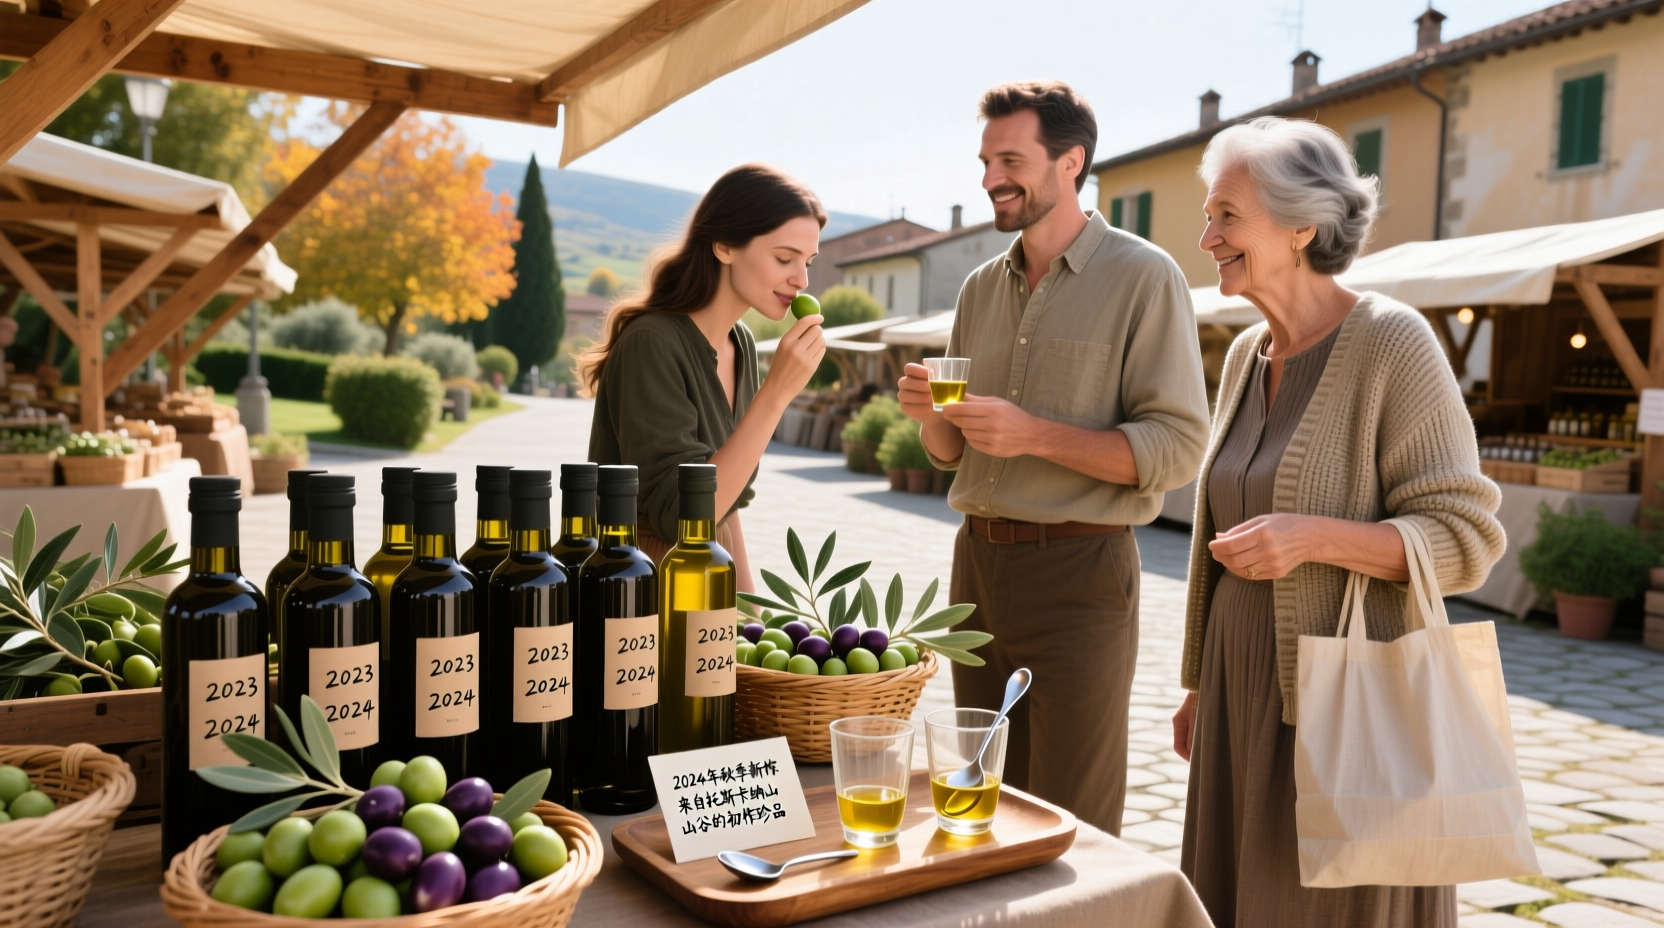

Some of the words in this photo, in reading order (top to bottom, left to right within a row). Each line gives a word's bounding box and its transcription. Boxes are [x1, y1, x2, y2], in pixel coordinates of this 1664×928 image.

[617, 633, 656, 655] 2023
[697, 625, 734, 644] 2023
[527, 642, 569, 665] 2023
[695, 654, 734, 674] 2024
[325, 664, 374, 689] 2023
[429, 654, 474, 677] 2023
[615, 665, 656, 685] 2024
[205, 676, 258, 702] 2023
[524, 676, 570, 696] 2024
[325, 699, 375, 722] 2024
[428, 688, 476, 712] 2024
[203, 713, 260, 740] 2024
